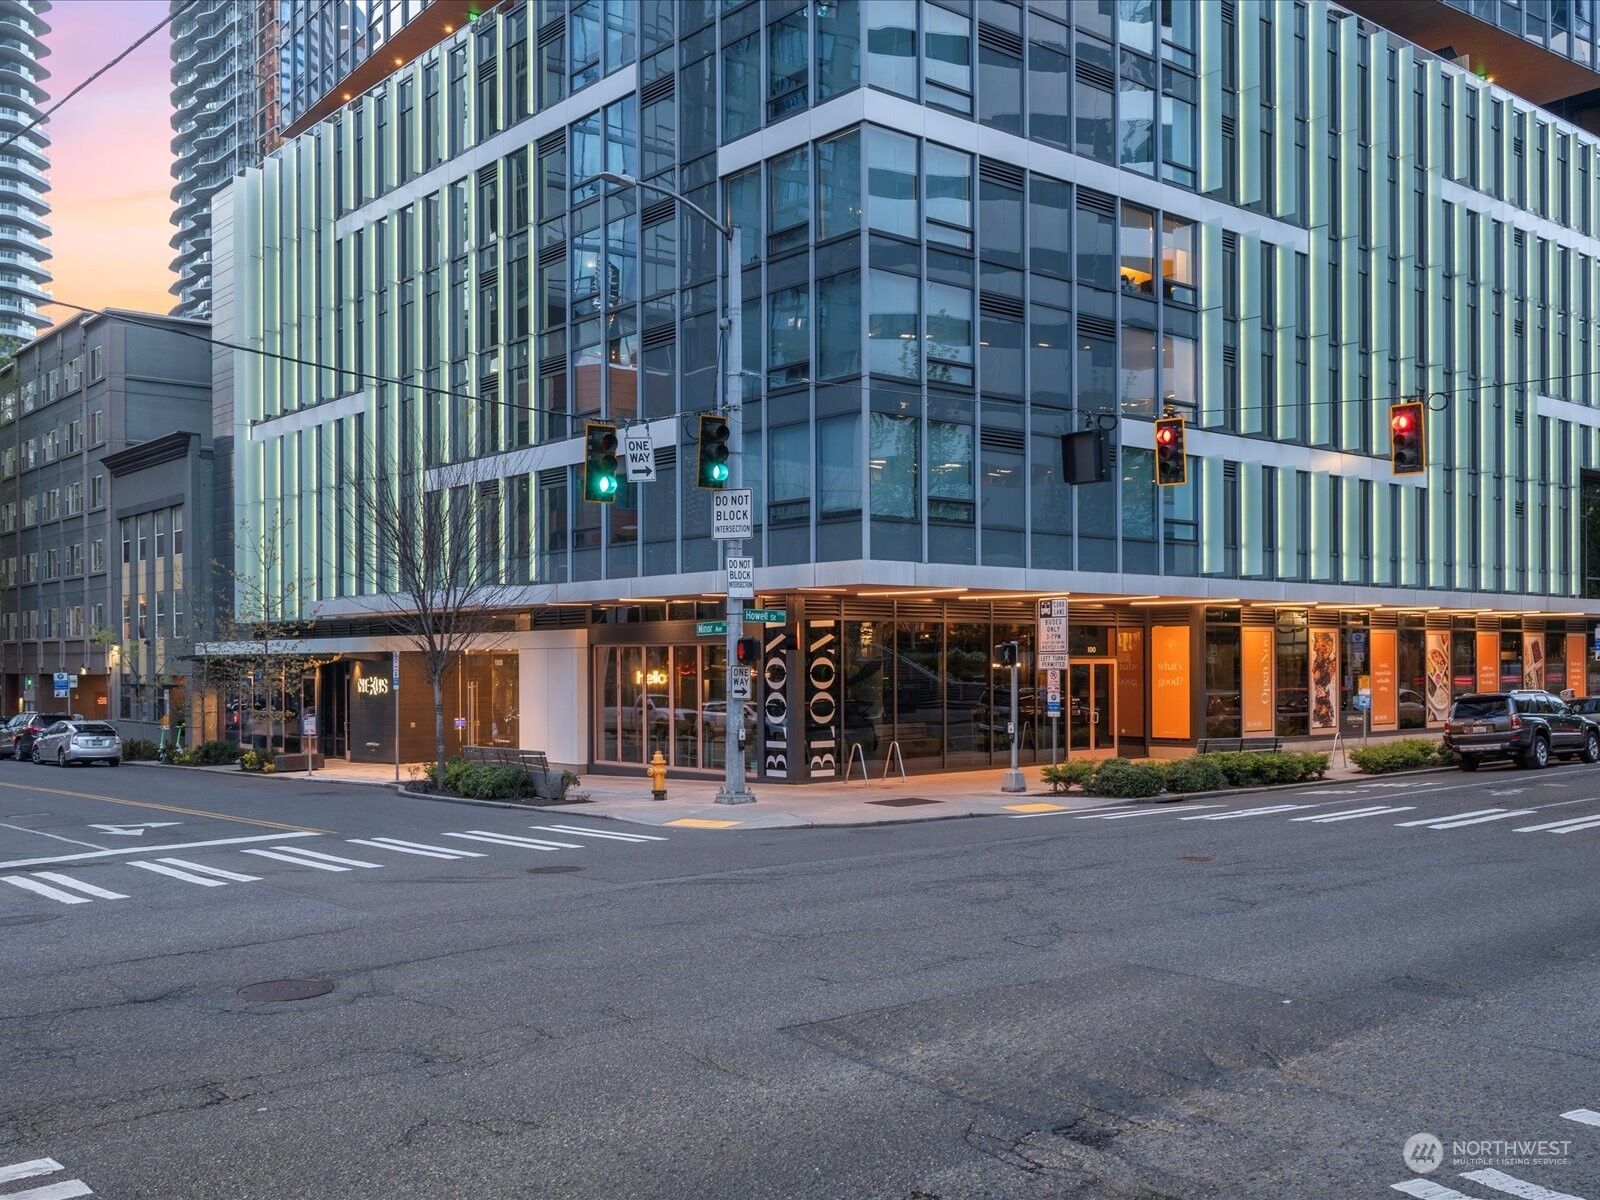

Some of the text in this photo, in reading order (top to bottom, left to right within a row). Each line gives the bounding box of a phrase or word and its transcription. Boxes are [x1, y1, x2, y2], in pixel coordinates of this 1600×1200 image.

[628, 441, 650, 451] ONE
[629, 453, 650, 463] WAY
[715, 495, 749, 506] DO NOT
[716, 510, 749, 521] BLOCK
[715, 525, 750, 533] INTERSECTION
[729, 560, 751, 569] DO NOT
[729, 571, 751, 580] BLOCK
[745, 610, 769, 620] Howell
[636, 670, 667, 684] hello
[733, 668, 749, 677] ONE
[357, 676, 388, 695] NEXUS
[733, 678, 749, 687] WAY
